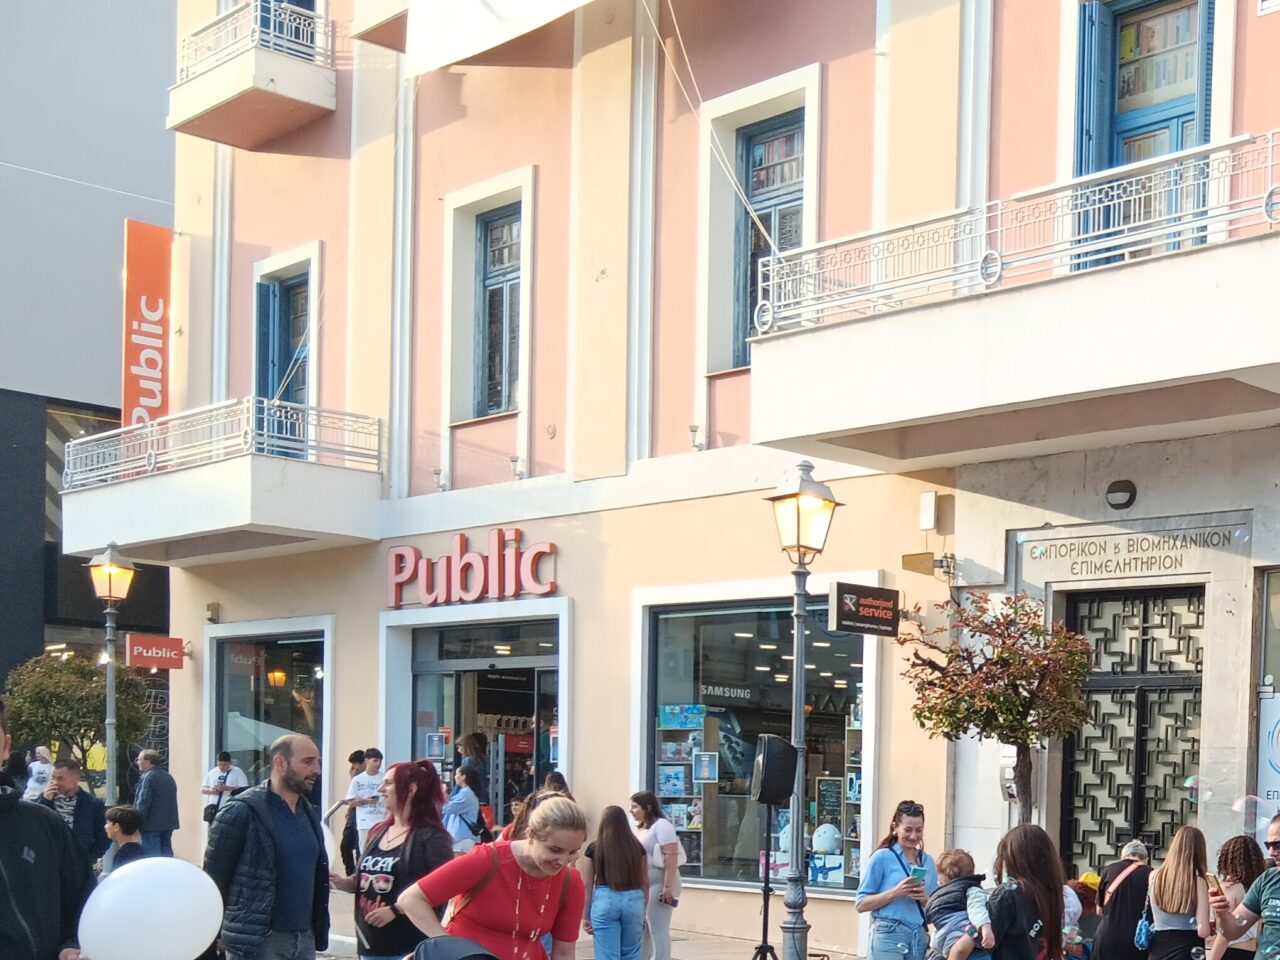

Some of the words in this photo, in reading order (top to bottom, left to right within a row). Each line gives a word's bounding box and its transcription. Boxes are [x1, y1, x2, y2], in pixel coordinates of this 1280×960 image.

[1127, 530, 1232, 553] ΒΙΟΜΗΧΑΝΙΚΟΝ
[386, 528, 557, 610] Public
[1070, 554, 1183, 576] ΕΠΙΜΕΛΗΤΗΡΙΟΝ
[858, 606, 893, 619] service
[133, 646, 179, 659] Public
[701, 684, 750, 699] SAMSUNG
